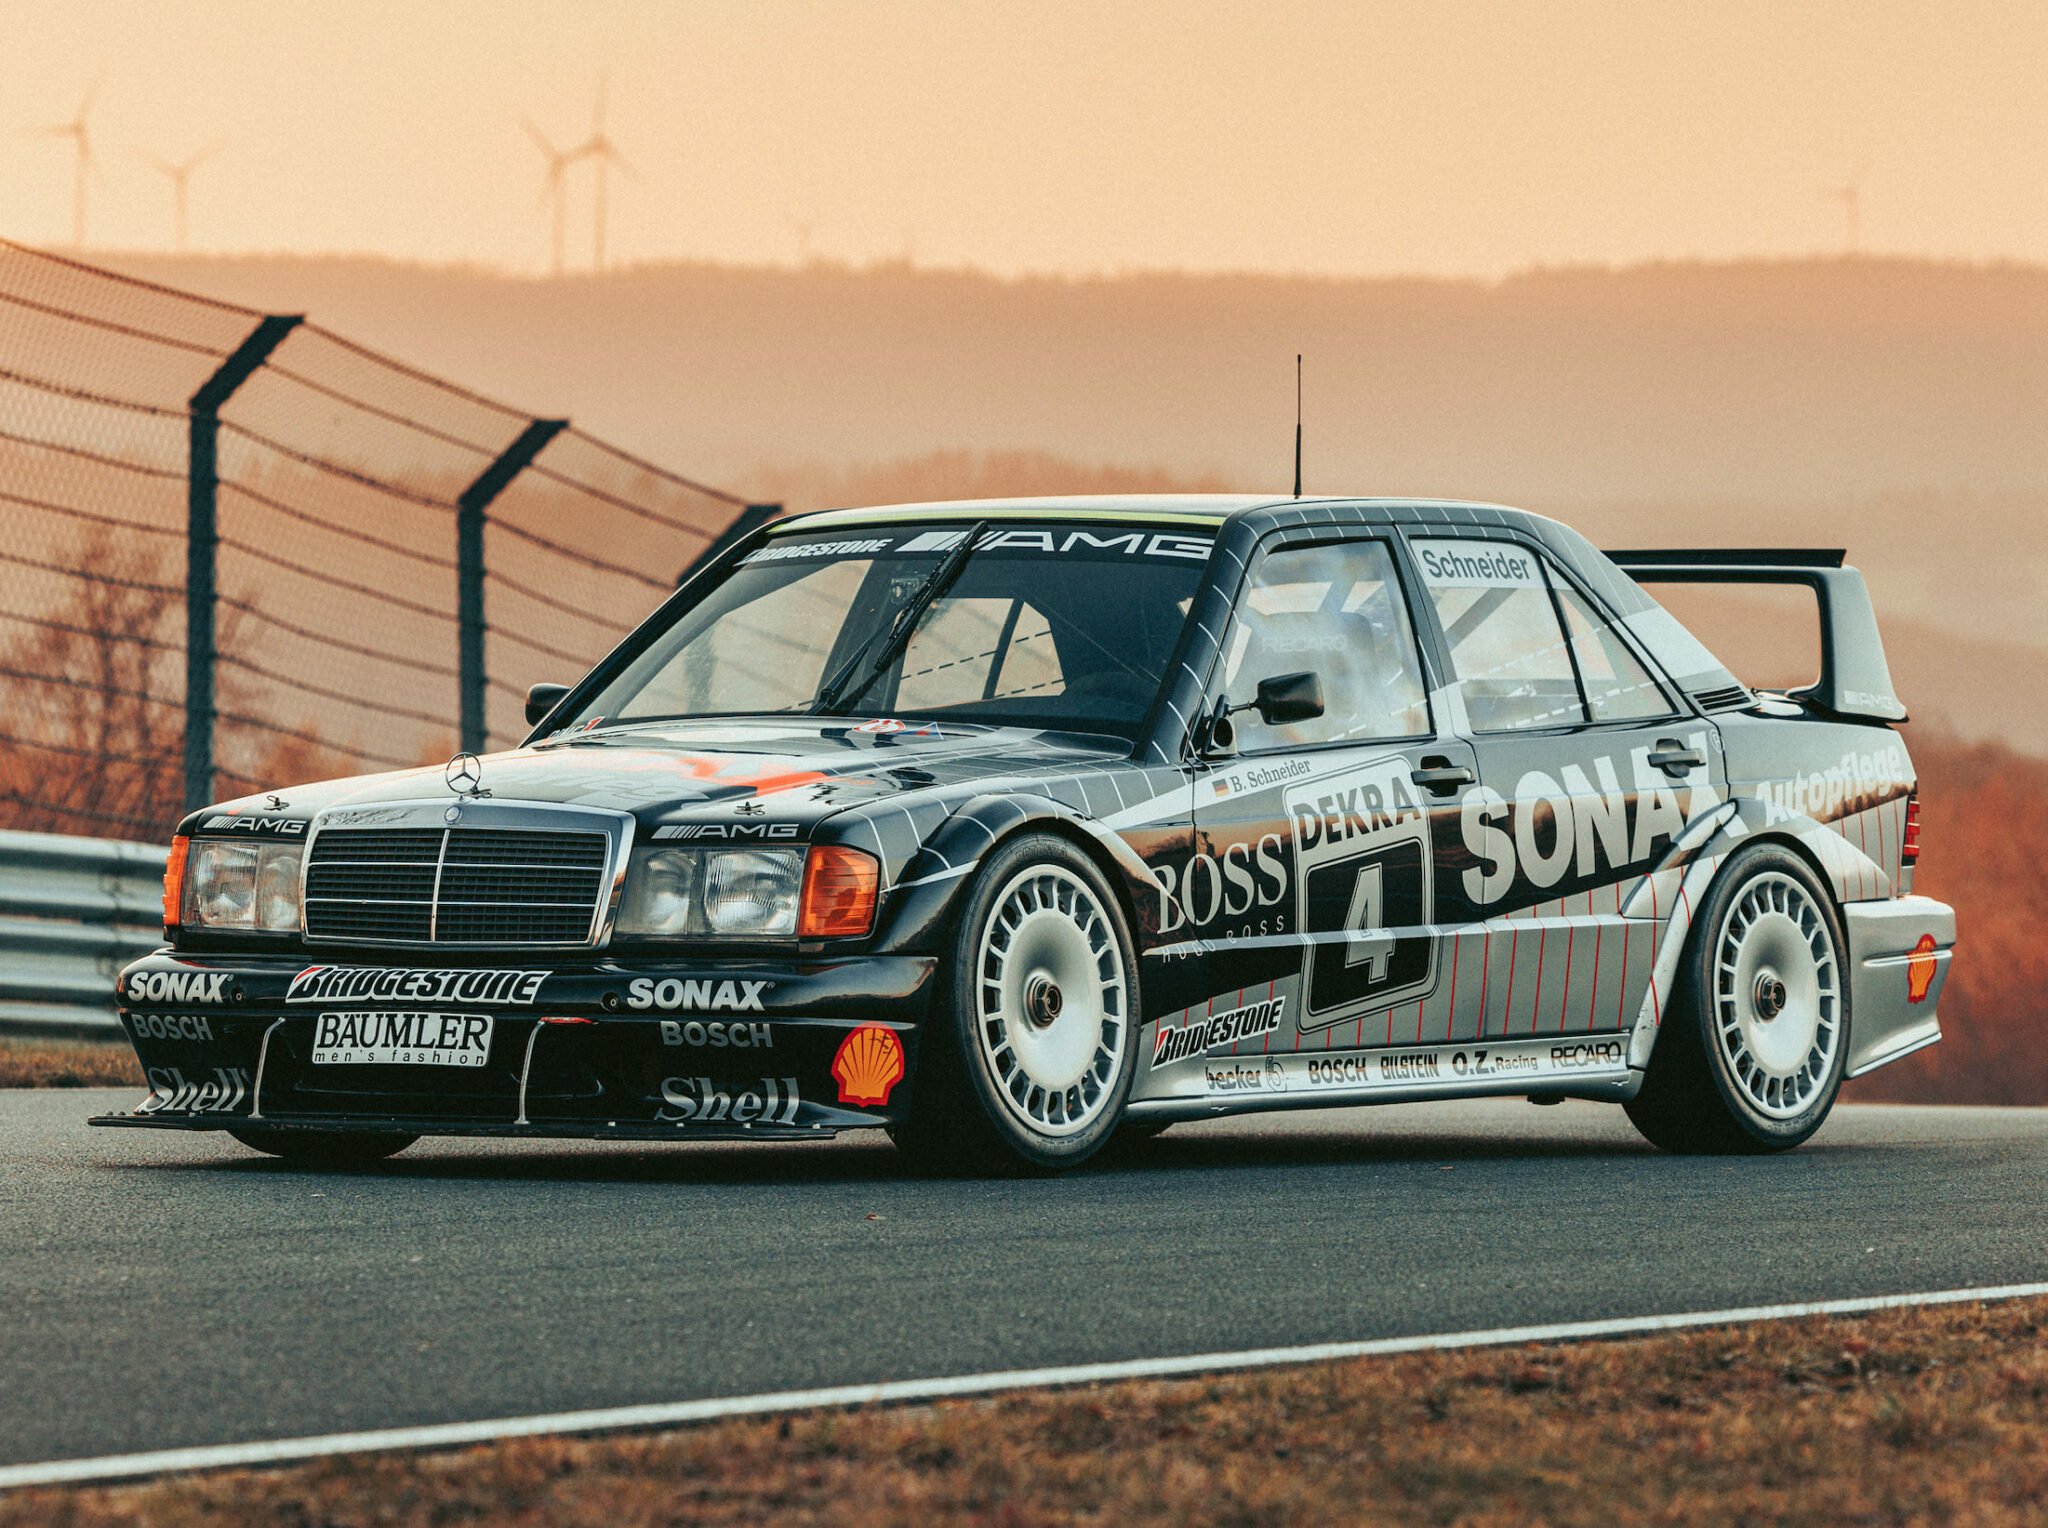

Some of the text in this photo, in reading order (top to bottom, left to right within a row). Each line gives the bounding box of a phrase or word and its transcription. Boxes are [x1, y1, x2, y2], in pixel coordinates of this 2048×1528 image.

[979, 531, 1215, 560] AMG
[1422, 549, 1531, 580] Schneider
[1230, 759, 1313, 792] B. Schneider
[1756, 745, 1903, 828] Autopflege
[229, 816, 307, 834] AMG
[1292, 776, 1422, 852] DEKRA
[1460, 731, 1750, 905] SONAX
[693, 823, 800, 839] AMG
[1150, 833, 1289, 935] BOSS
[1226, 915, 1285, 944] BOSS
[1343, 861, 1396, 985] 4
[128, 971, 230, 1003] SONAX
[287, 964, 550, 1003] BRIDGESTONE
[627, 978, 768, 1011] SONAX
[131, 1013, 214, 1041] BOSCH
[316, 1013, 488, 1053] BÄUMLER
[660, 1020, 773, 1048] BOSCH
[1151, 998, 1285, 1068] BRIDGESTONE
[314, 1050, 486, 1065] men's fashion
[1380, 1053, 1440, 1080] BILSTEIN
[1551, 1040, 1622, 1069] RECARO
[1205, 1064, 1262, 1090] becker
[1308, 1057, 1369, 1085] BOSCH
[133, 1067, 245, 1113] Shell
[654, 1076, 800, 1126] Shell
